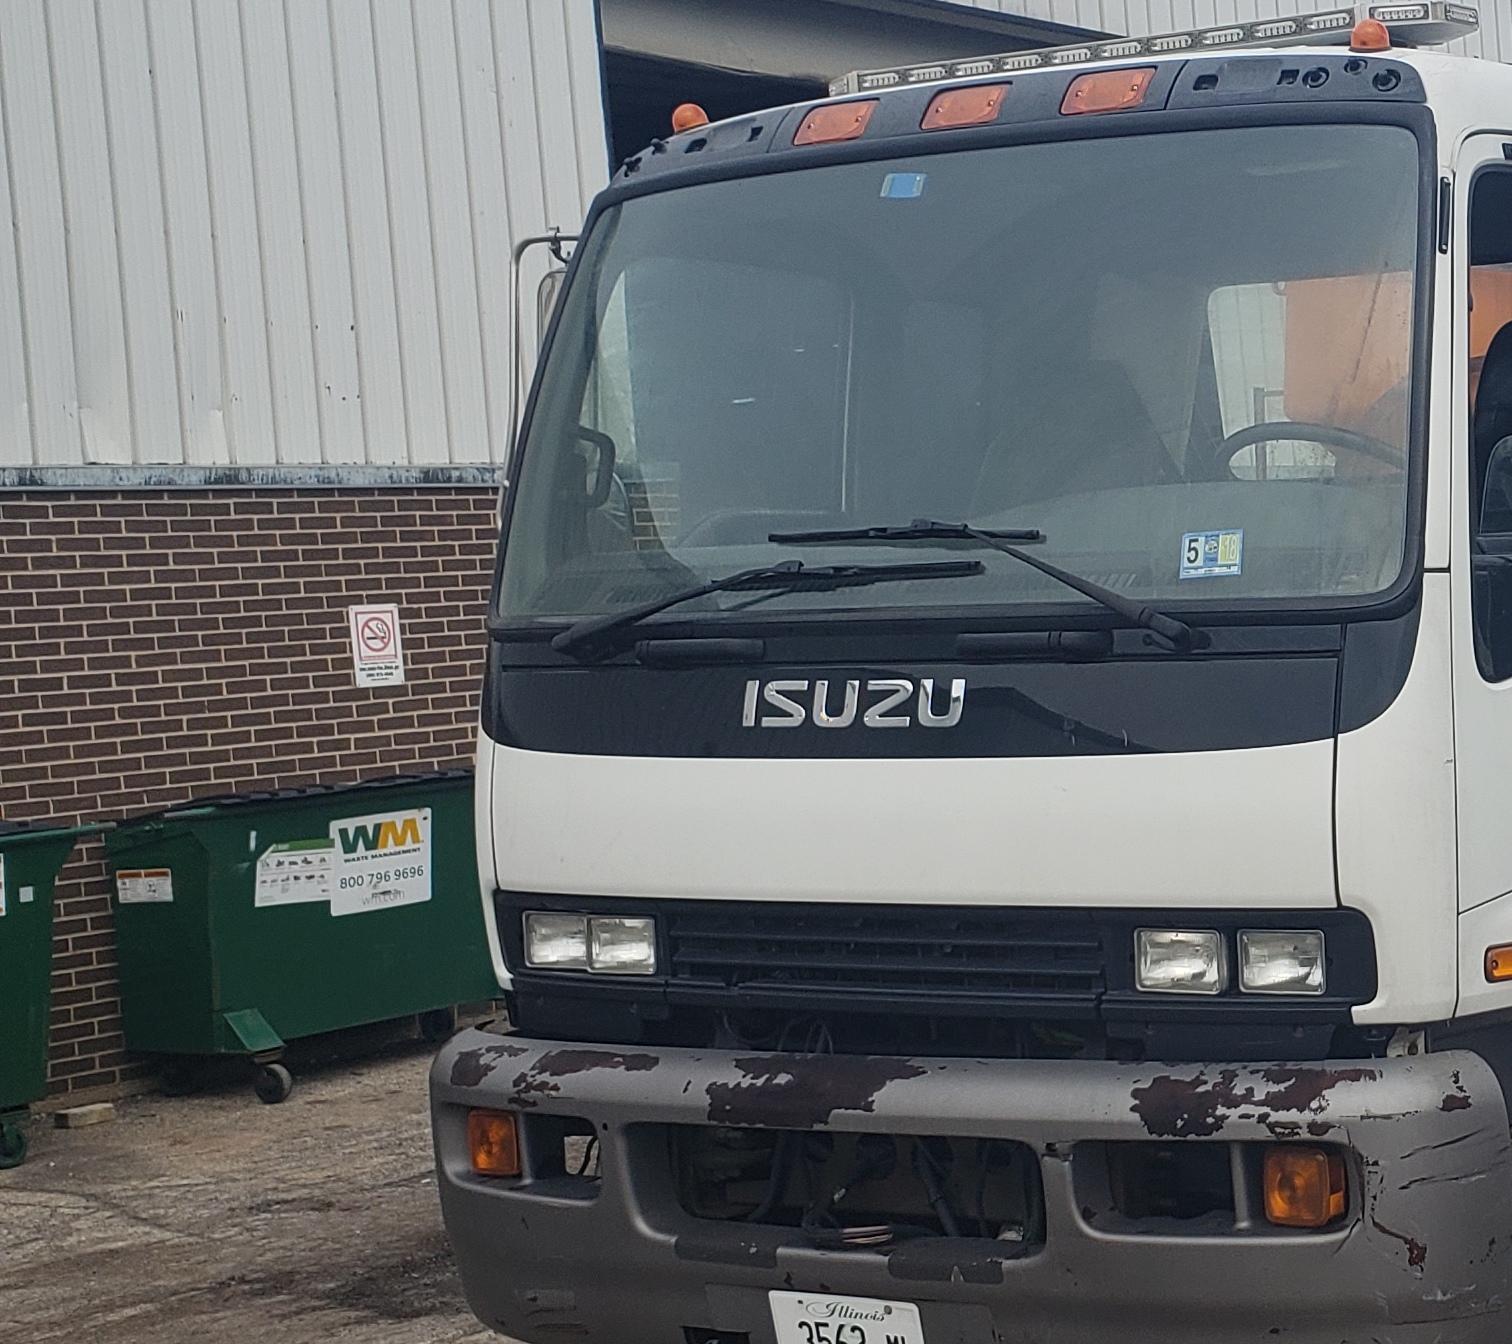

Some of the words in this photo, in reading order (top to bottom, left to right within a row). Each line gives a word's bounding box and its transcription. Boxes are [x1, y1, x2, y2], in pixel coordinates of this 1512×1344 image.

[1187, 538, 1199, 564] 5
[1225, 536, 1237, 560] 18
[742, 679, 966, 728] ISUZU
[338, 818, 421, 854] WM
[344, 855, 368, 863] WASTE
[371, 848, 421, 859] MANAGEMENT
[340, 875, 364, 889] 800
[367, 871, 391, 885] 796
[394, 865, 424, 880] 9696
[806, 1302, 885, 1322] Illinois
